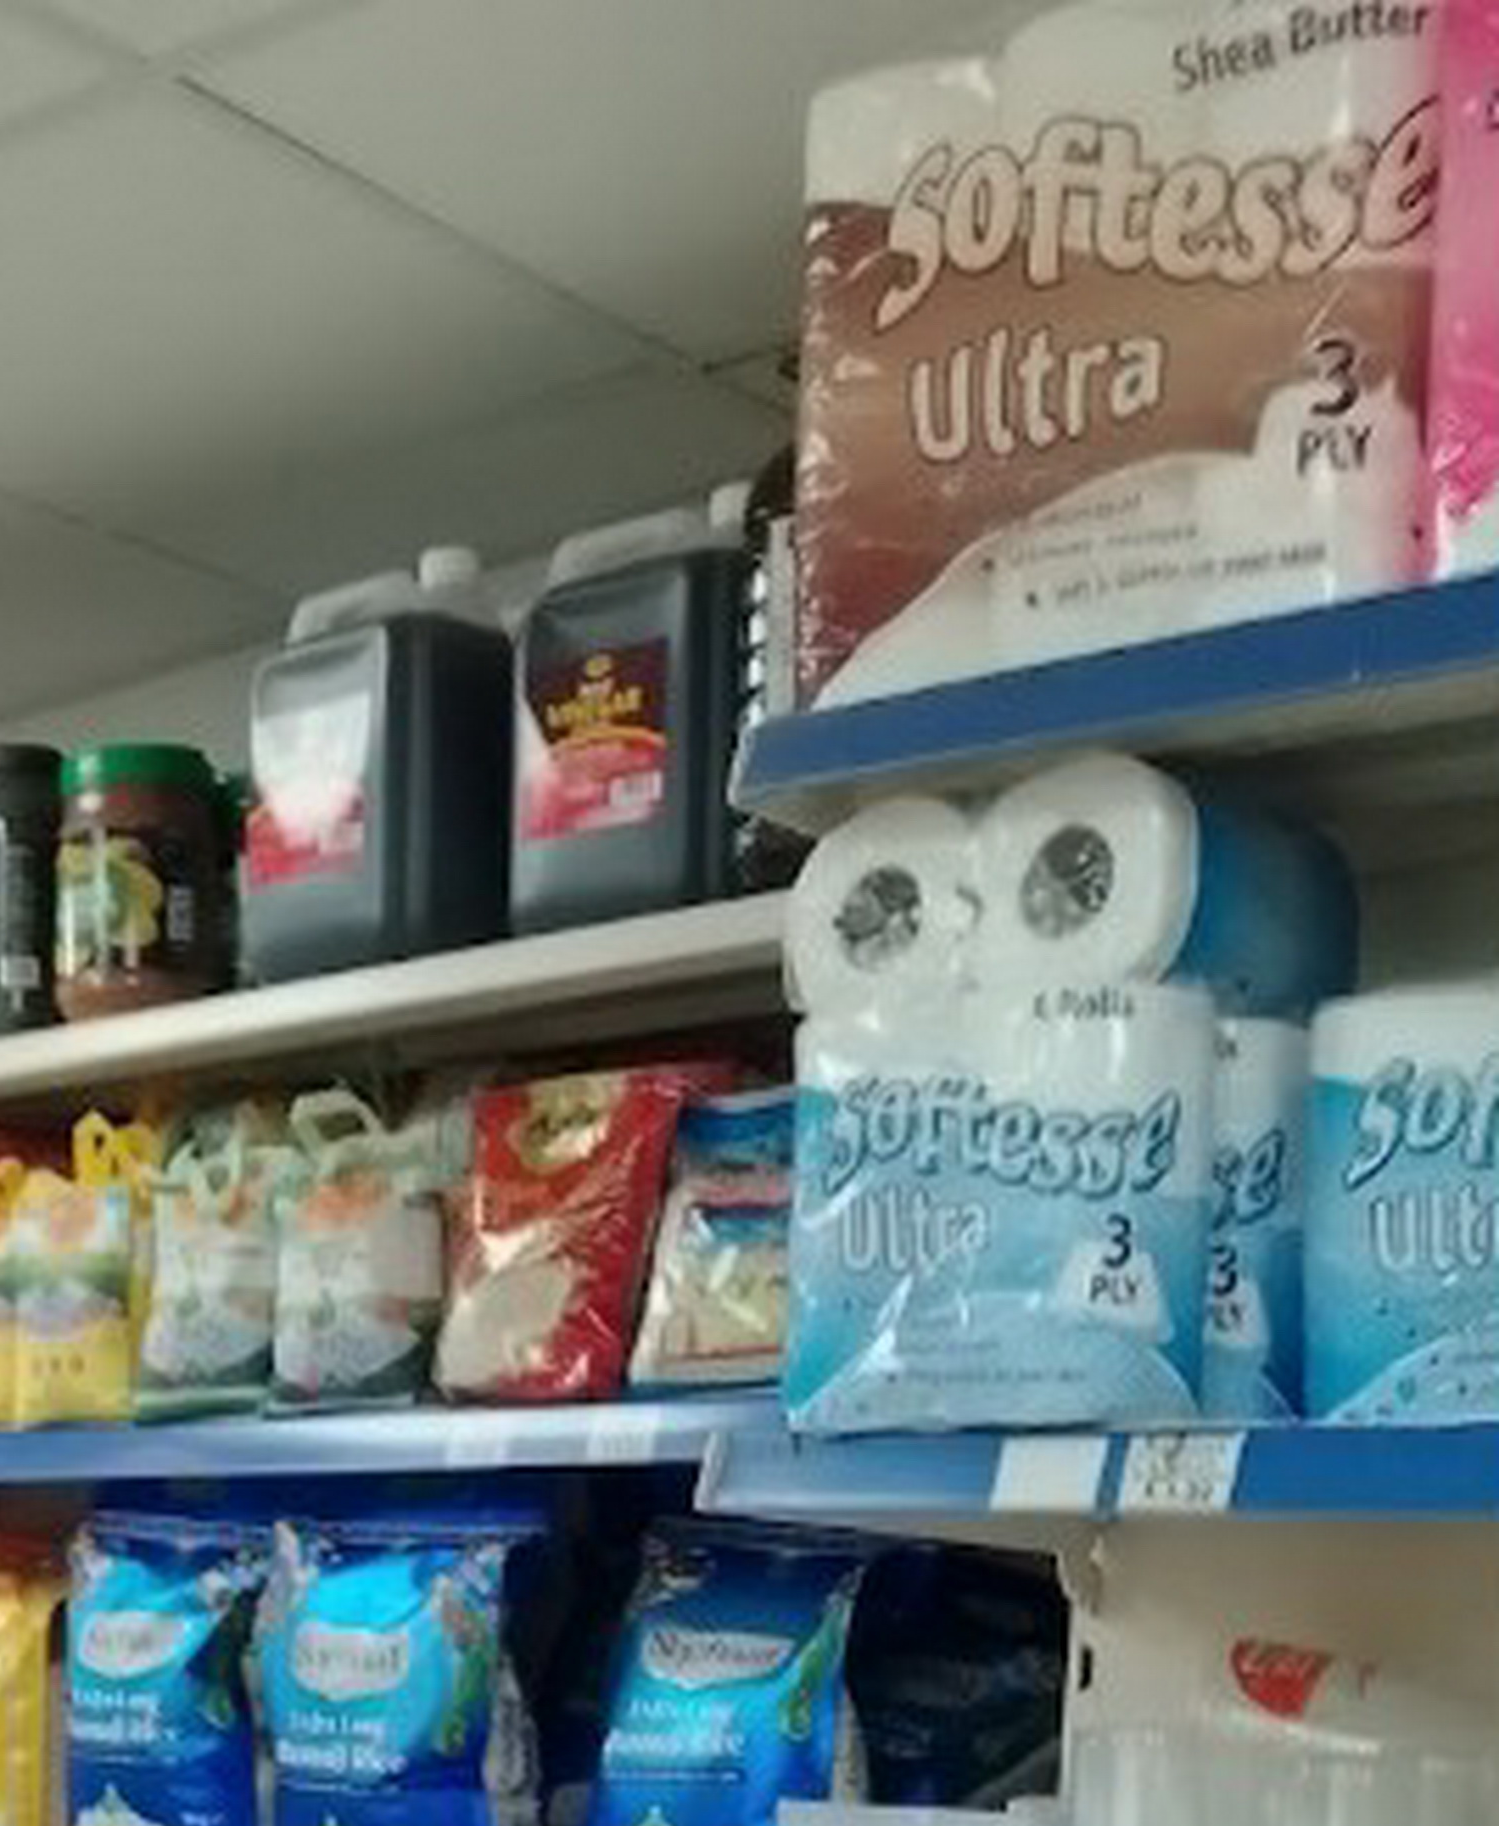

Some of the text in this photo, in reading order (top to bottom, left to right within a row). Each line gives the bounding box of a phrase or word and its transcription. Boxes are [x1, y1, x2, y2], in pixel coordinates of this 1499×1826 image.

[1171, 2, 1431, 92] Shea Butter
[1309, 338, 1359, 418] 3
[1296, 424, 1373, 476] PLY
[1101, 1212, 1135, 1267] 3
[1088, 1273, 1143, 1304] PLY
